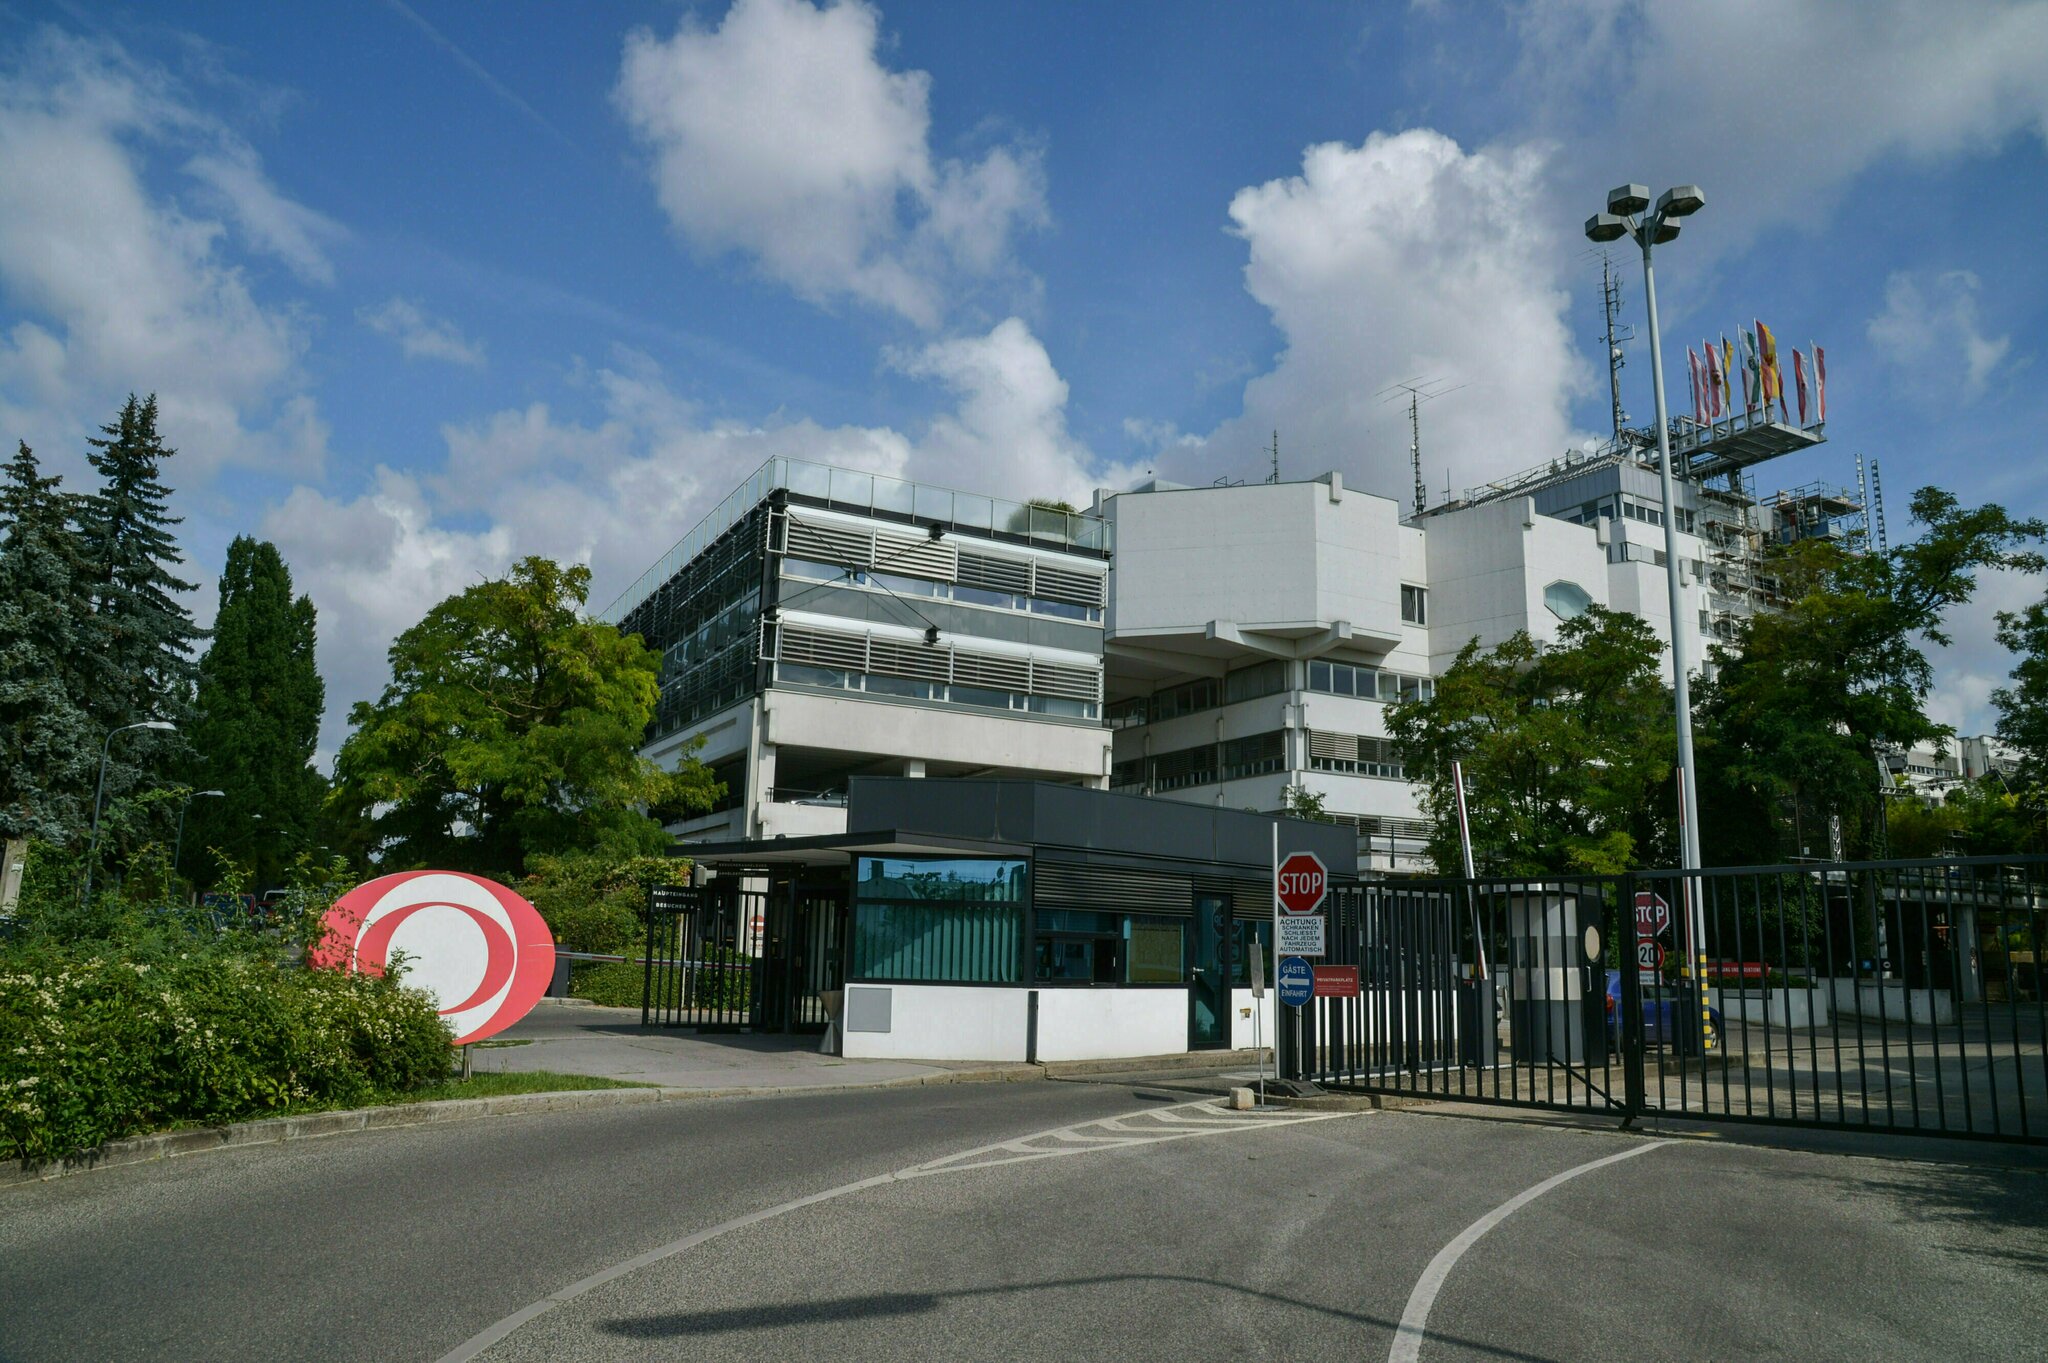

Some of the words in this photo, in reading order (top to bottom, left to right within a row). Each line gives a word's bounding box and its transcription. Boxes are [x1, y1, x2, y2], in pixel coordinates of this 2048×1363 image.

[1280, 872, 1322, 895] STOP
[653, 890, 698, 898] HAUPTEINGANG
[1280, 918, 1318, 926] ACHTUNG
[1282, 963, 1306, 975] GÄSTE
[1281, 989, 1308, 998] EINFAHRT
